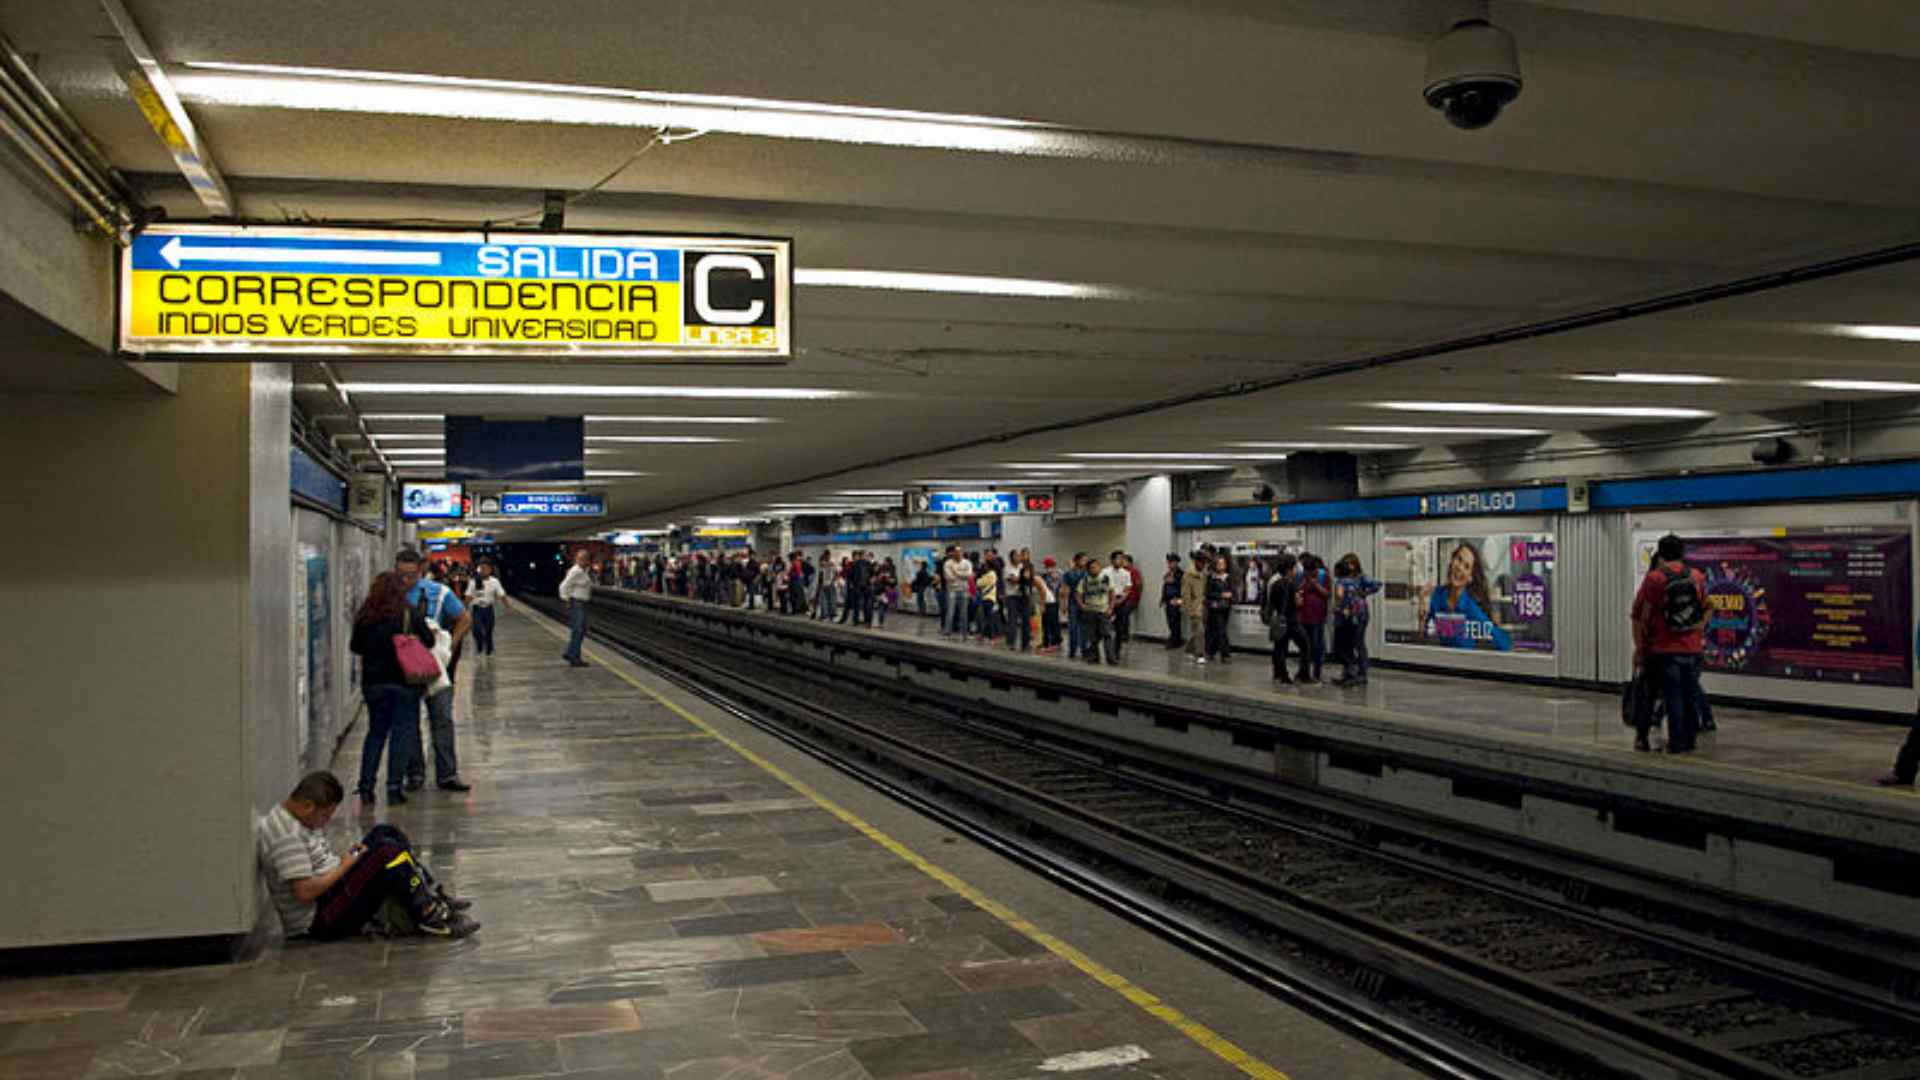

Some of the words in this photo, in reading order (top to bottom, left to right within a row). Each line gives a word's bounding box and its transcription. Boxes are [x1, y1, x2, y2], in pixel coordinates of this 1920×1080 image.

[477, 246, 659, 279] SALIDA
[158, 275, 657, 312] CORRESPONDENCIA
[694, 254, 765, 325] C
[158, 312, 268, 335] INDIOS
[279, 314, 417, 336] VERDES
[449, 317, 657, 340] UNIVERSIDAD
[1437, 491, 1516, 513] HIDALGO
